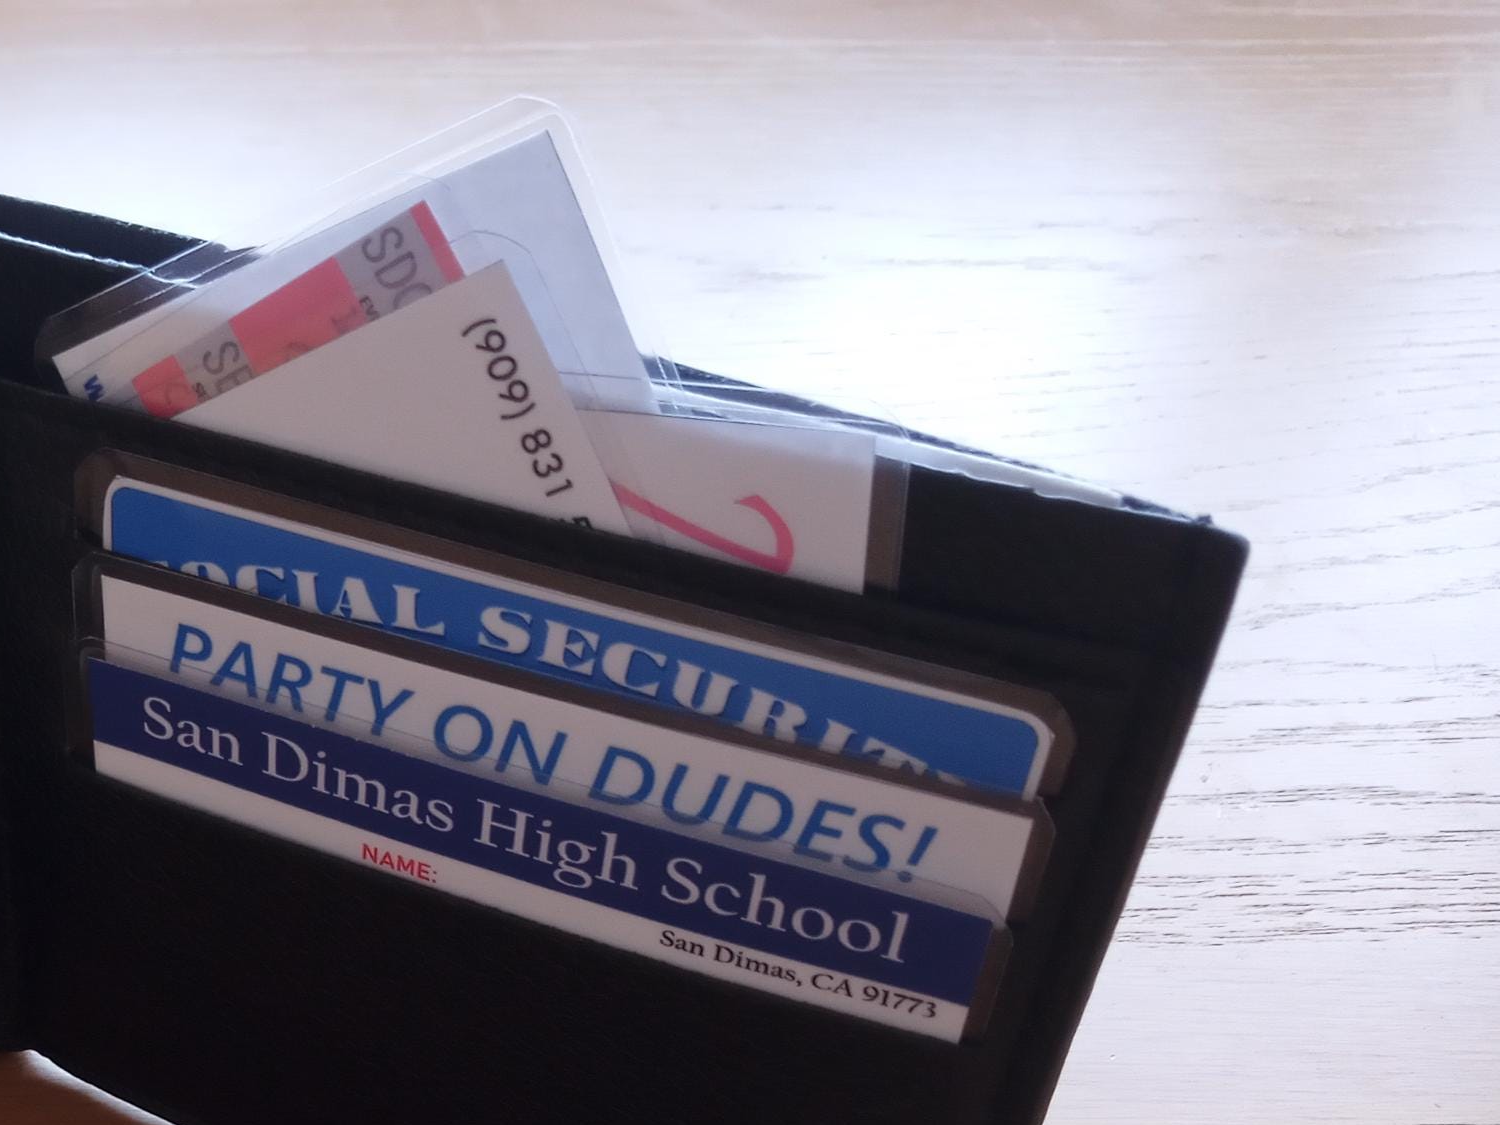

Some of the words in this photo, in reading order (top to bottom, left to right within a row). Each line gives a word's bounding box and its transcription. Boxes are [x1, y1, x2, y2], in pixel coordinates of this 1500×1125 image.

[462, 319, 536, 420] (909)
[521, 429, 573, 498] 831
[160, 561, 446, 638] CIAL
[478, 606, 966, 787] SECURI
[169, 622, 416, 738] PARTY
[432, 703, 569, 788] ON
[588, 744, 940, 885] DUDES!
[142, 696, 244, 767] San
[261, 730, 456, 834] Dimas
[473, 797, 640, 890] High
[660, 856, 911, 965] School
[361, 842, 439, 884] NAME:
[660, 929, 705, 959] San
[715, 945, 803, 988] Dimas,
[811, 972, 854, 999] CA
[862, 984, 938, 1019] 91773
